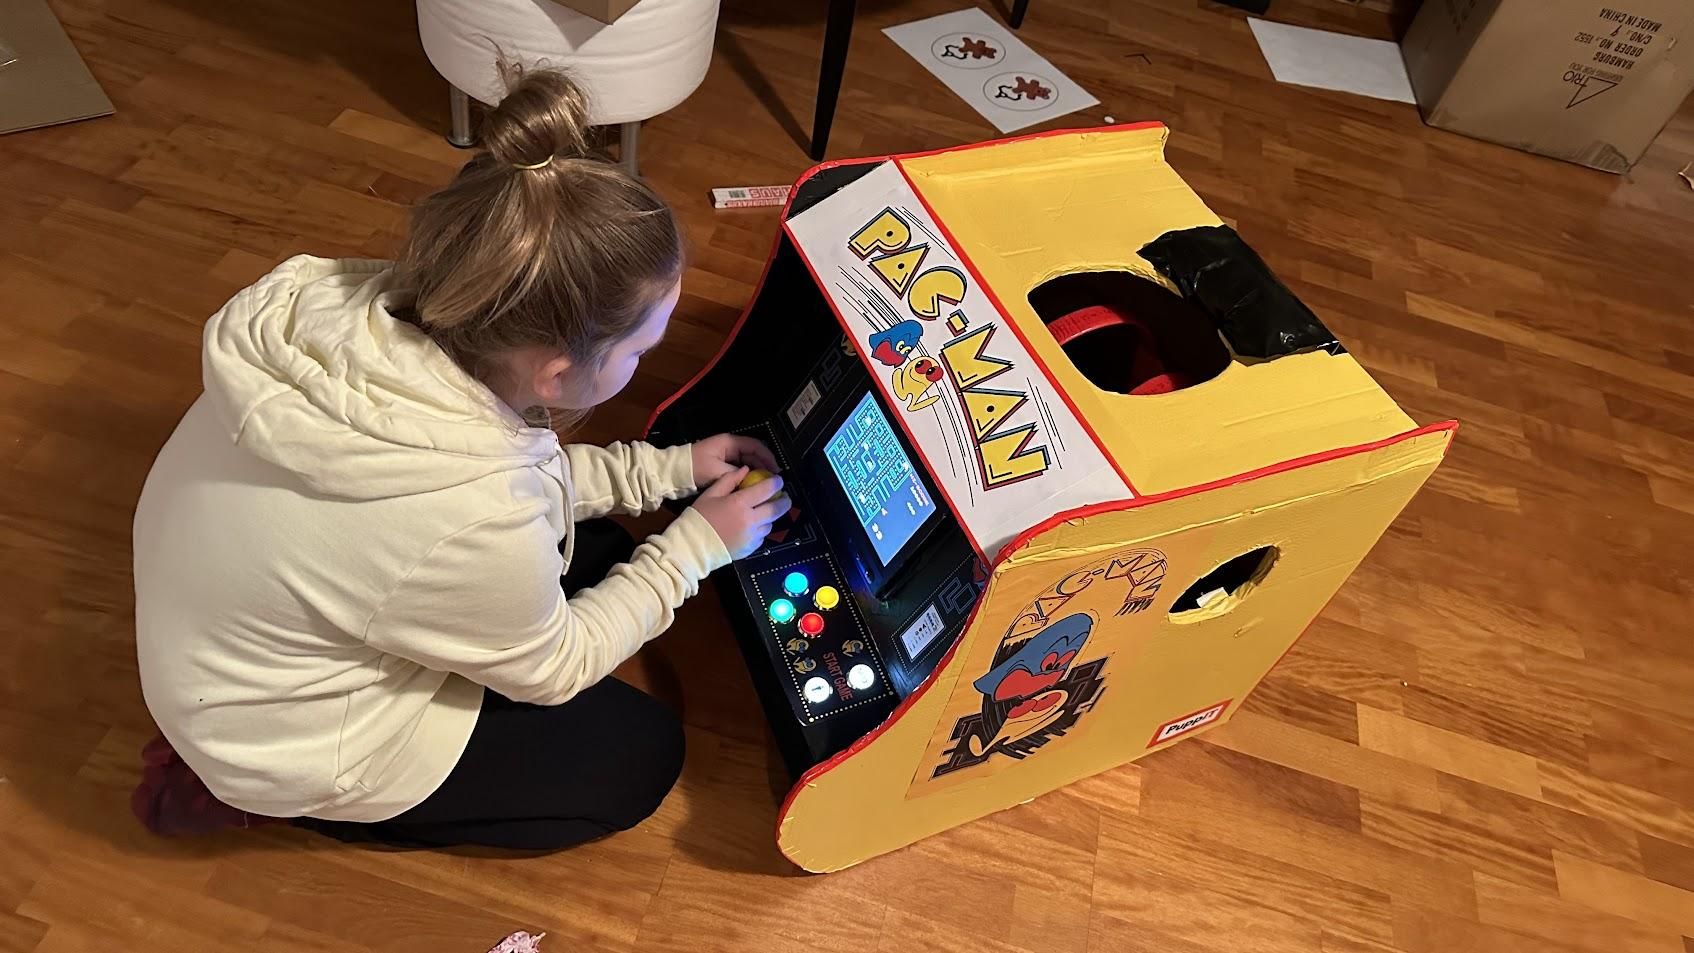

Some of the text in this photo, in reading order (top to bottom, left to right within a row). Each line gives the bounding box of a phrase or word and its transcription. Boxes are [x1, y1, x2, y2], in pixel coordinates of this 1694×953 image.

[1600, 8, 1662, 32] MADE IN CHINA
[1574, 31, 1594, 44] 1552
[1593, 51, 1635, 70] HAMBURG
[1614, 43, 1644, 57] ORDER
[1563, 71, 1587, 87] TRIO
[848, 206, 1051, 491] PAC-MAN
[1003, 551, 1167, 640] PAC-MAN
[822, 651, 855, 701] START GAME
